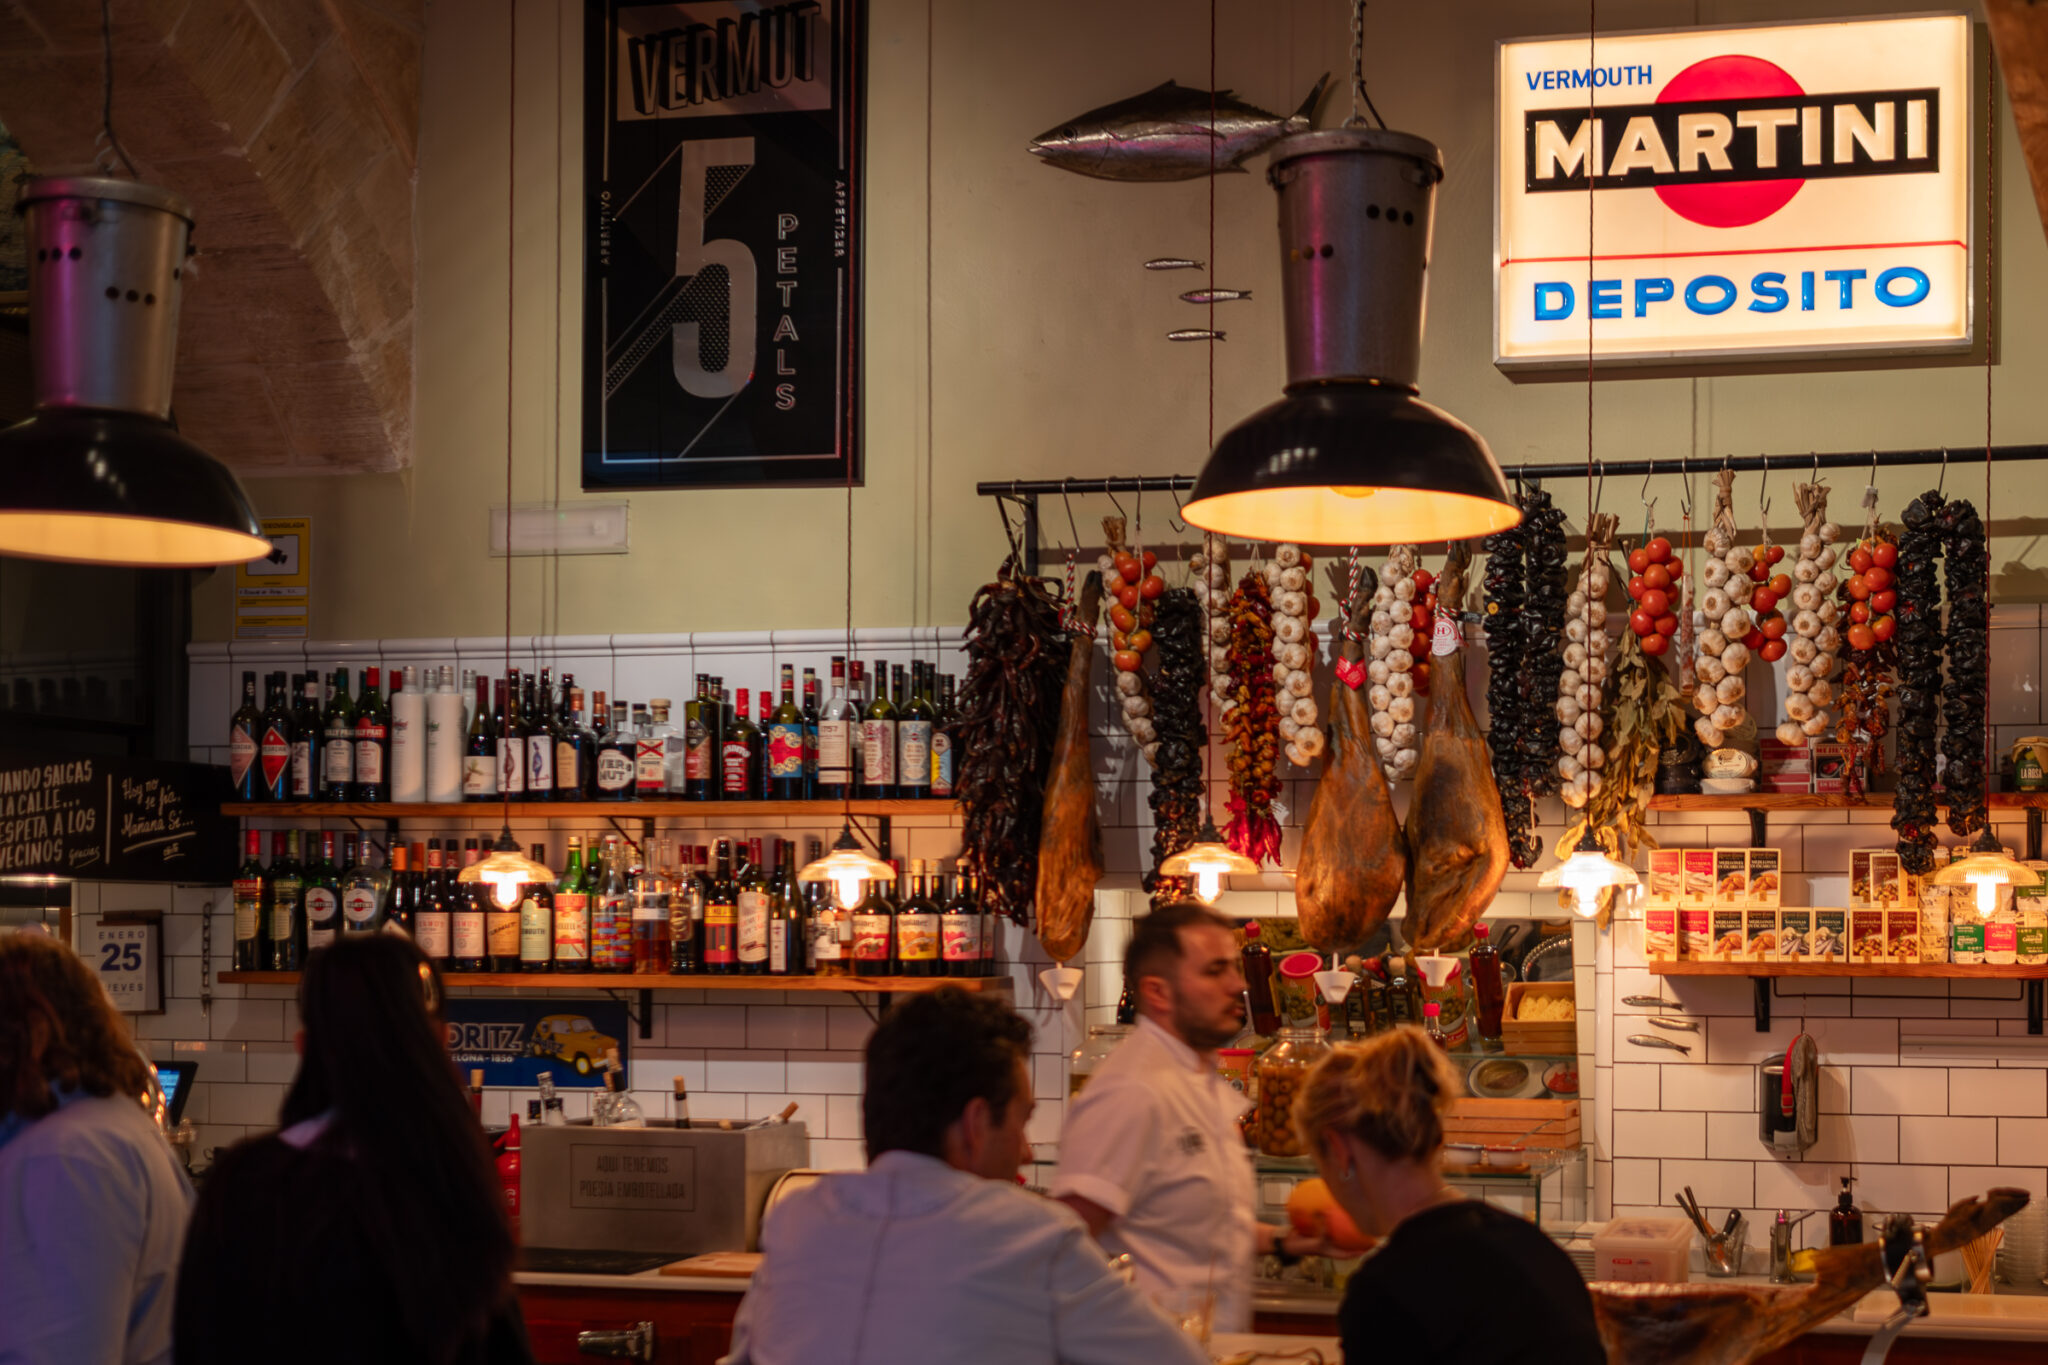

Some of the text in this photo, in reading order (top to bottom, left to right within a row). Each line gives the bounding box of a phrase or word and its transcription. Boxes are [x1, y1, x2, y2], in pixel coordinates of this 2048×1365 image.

[628, 2, 821, 115] VERMUT
[1526, 65, 1653, 91] VERMOUTH
[1535, 99, 1928, 180] MARTINI
[600, 190, 612, 265] APERITIVO
[834, 180, 846, 257] APPETIZER
[672, 136, 757, 399] 5
[1534, 266, 1931, 321] DEPOSITO
[773, 213, 799, 410] PETALS
[0, 767, 41, 795] ANDO
[145, 778, 160, 793] no
[0, 807, 97, 845] ESPETA A LOS
[121, 811, 165, 838] Mañana
[98, 930, 146, 940] ENERO
[101, 943, 142, 972] 25
[446, 1021, 526, 1052] ORITZ
[623, 1155, 669, 1174] TENEMOS
[616, 1181, 686, 1200] EMBOTELLADA
